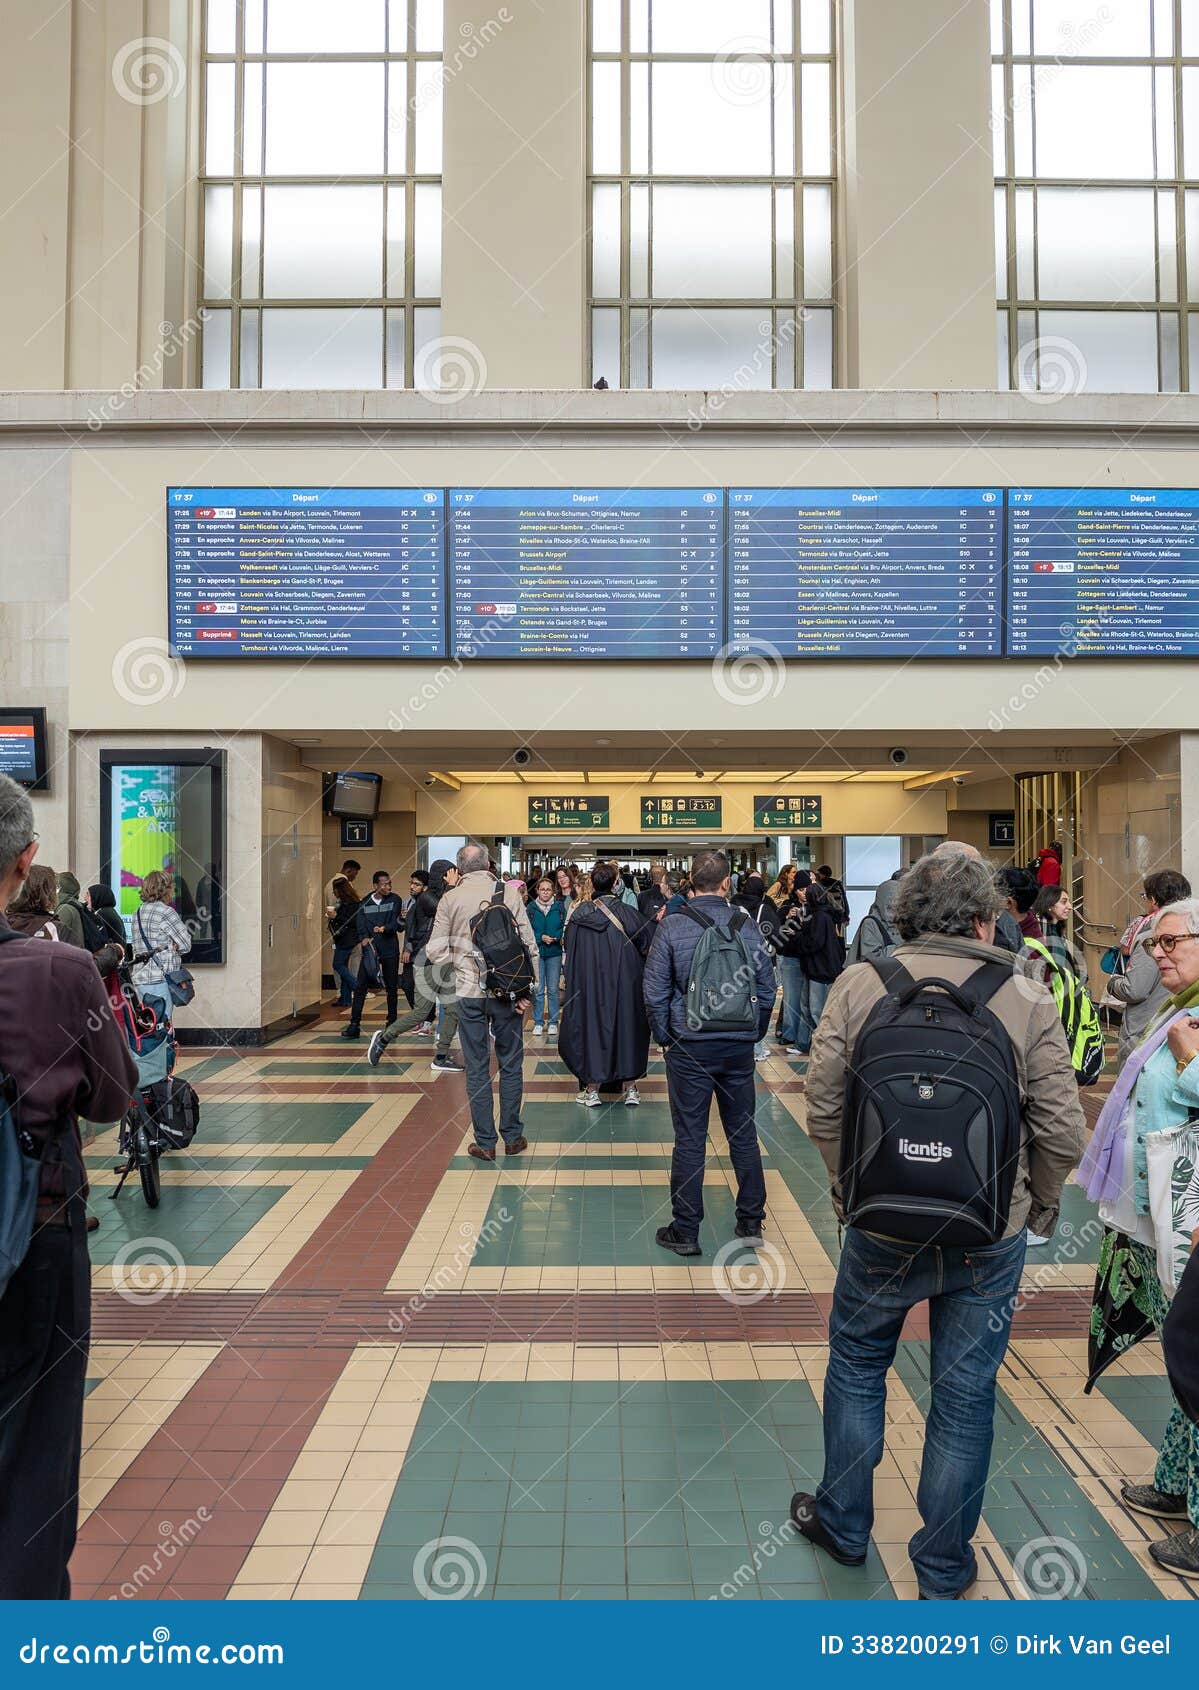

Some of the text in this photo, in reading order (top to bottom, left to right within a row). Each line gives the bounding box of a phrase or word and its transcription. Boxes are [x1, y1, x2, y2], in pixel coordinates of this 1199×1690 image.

[292, 494, 319, 502] Départ
[572, 494, 599, 503] Départ
[852, 494, 878, 503] Départ
[1130, 494, 1156, 502] Départ
[206, 523, 234, 532] approche
[822, 536, 831, 544] via
[206, 577, 235, 586] approche
[202, 631, 232, 639] Supprimé
[268, 644, 277, 652] via
[705, 802, 714, 810] 12
[898, 1138, 953, 1158] liantis
